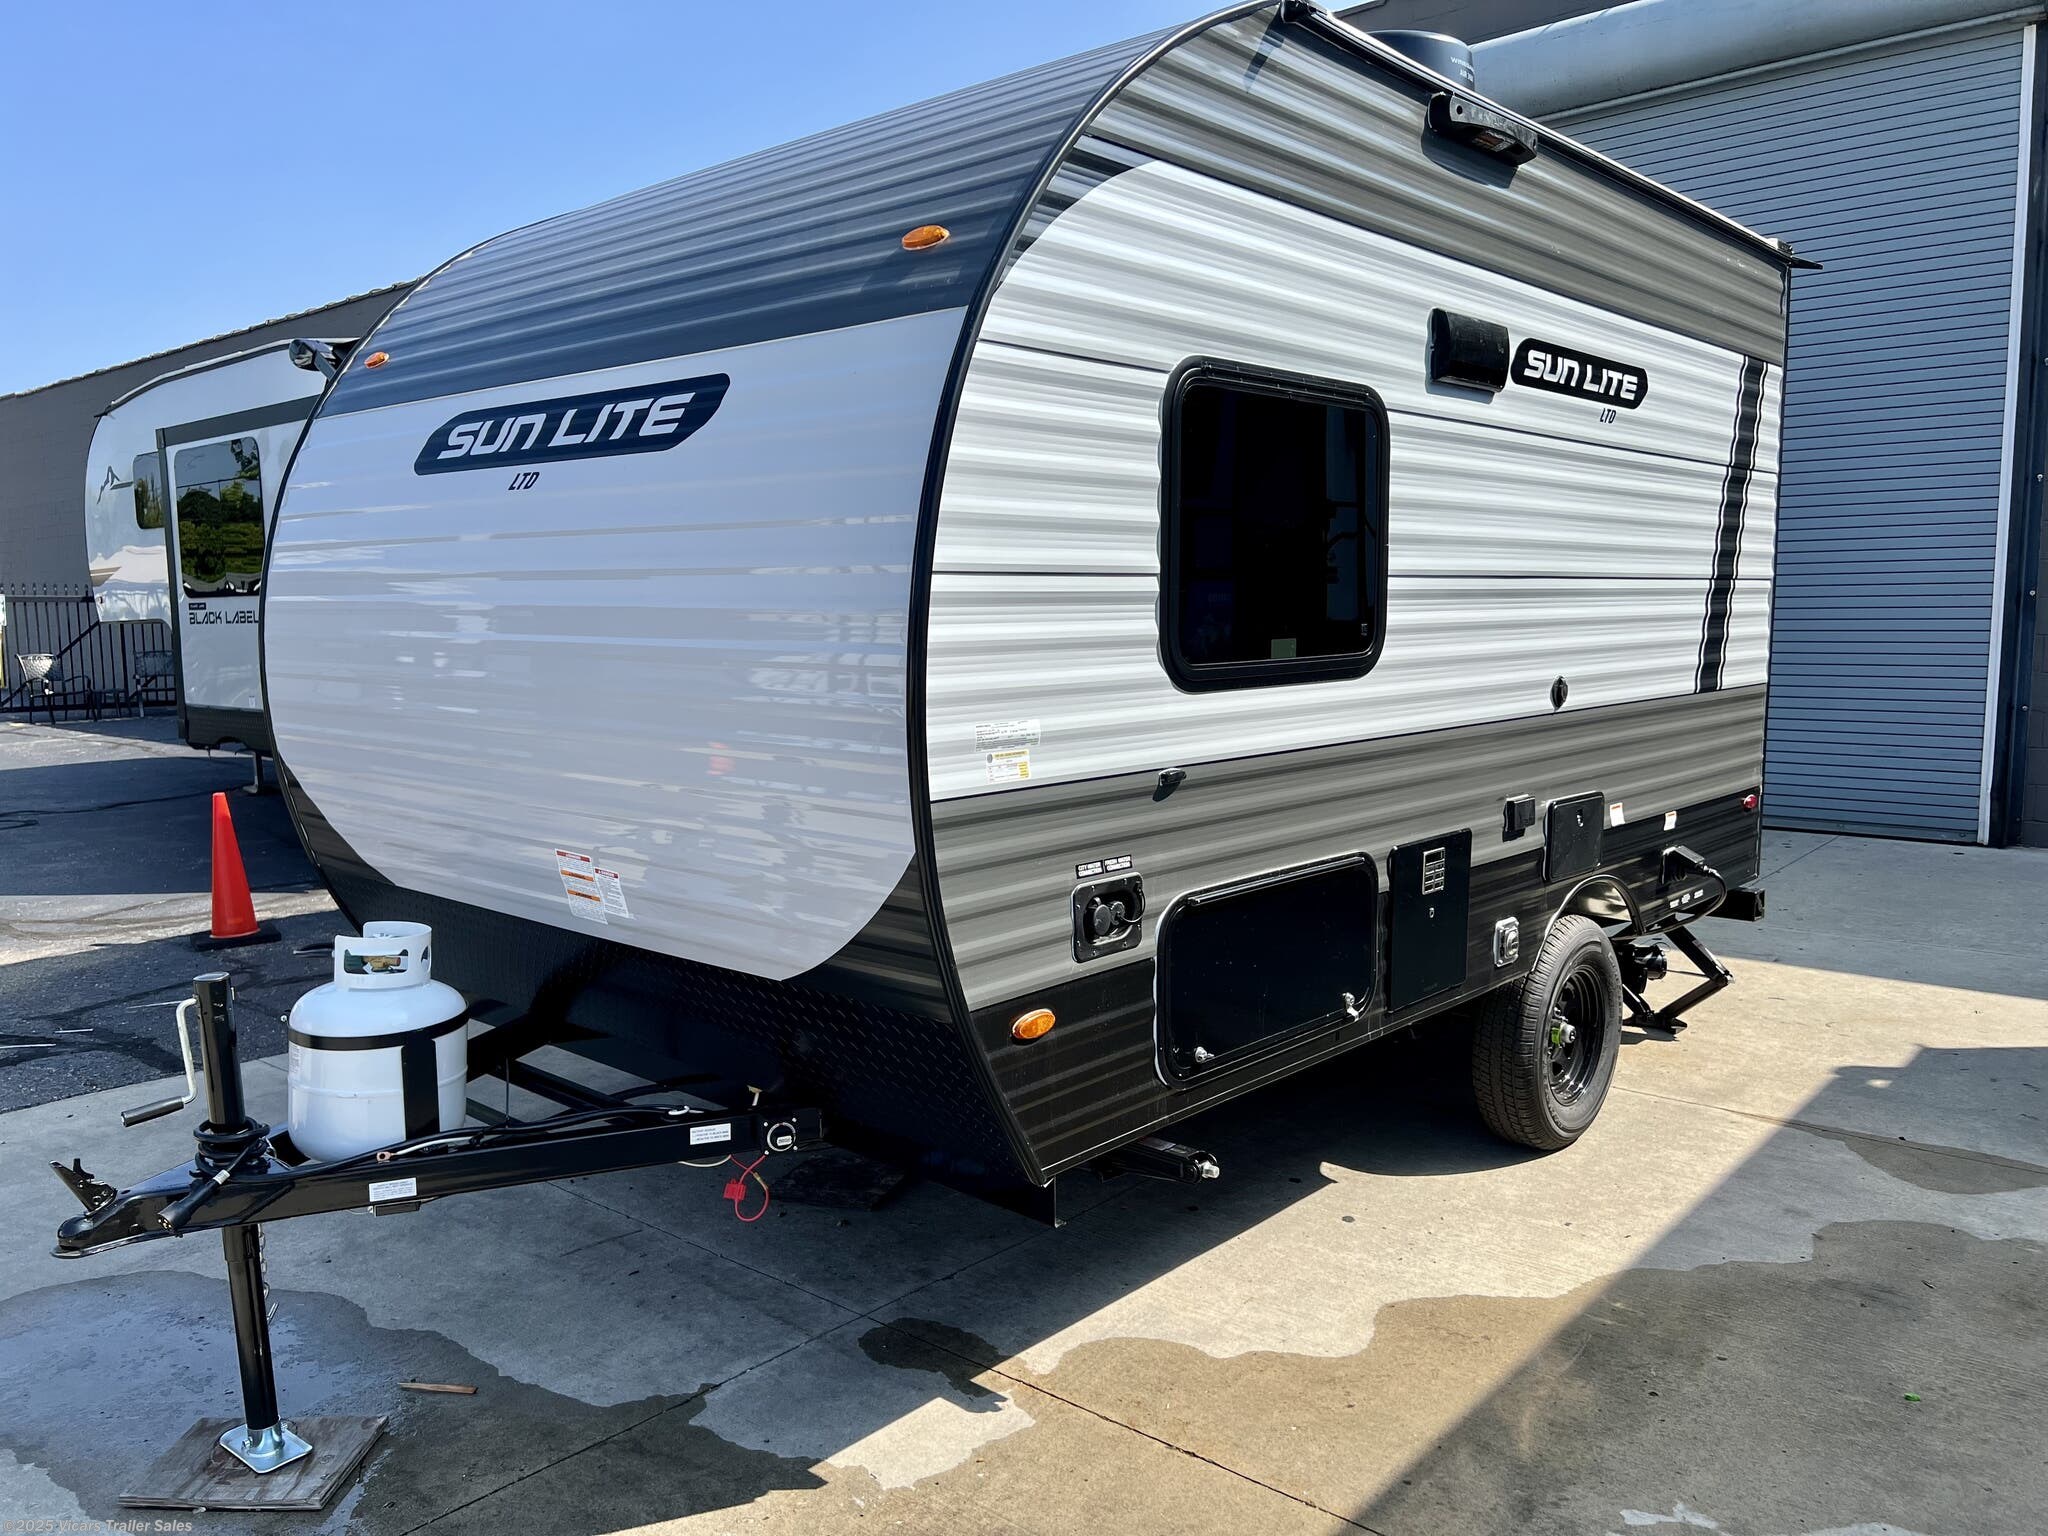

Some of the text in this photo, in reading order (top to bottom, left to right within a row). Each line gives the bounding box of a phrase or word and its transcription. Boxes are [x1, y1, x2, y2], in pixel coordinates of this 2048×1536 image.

[1523, 349, 1638, 400] SUN LITE
[437, 392, 697, 460] SUN LITE
[1599, 408, 1617, 425] LTD
[508, 471, 541, 492] LTD
[189, 610, 259, 624] BLACK LABEL
